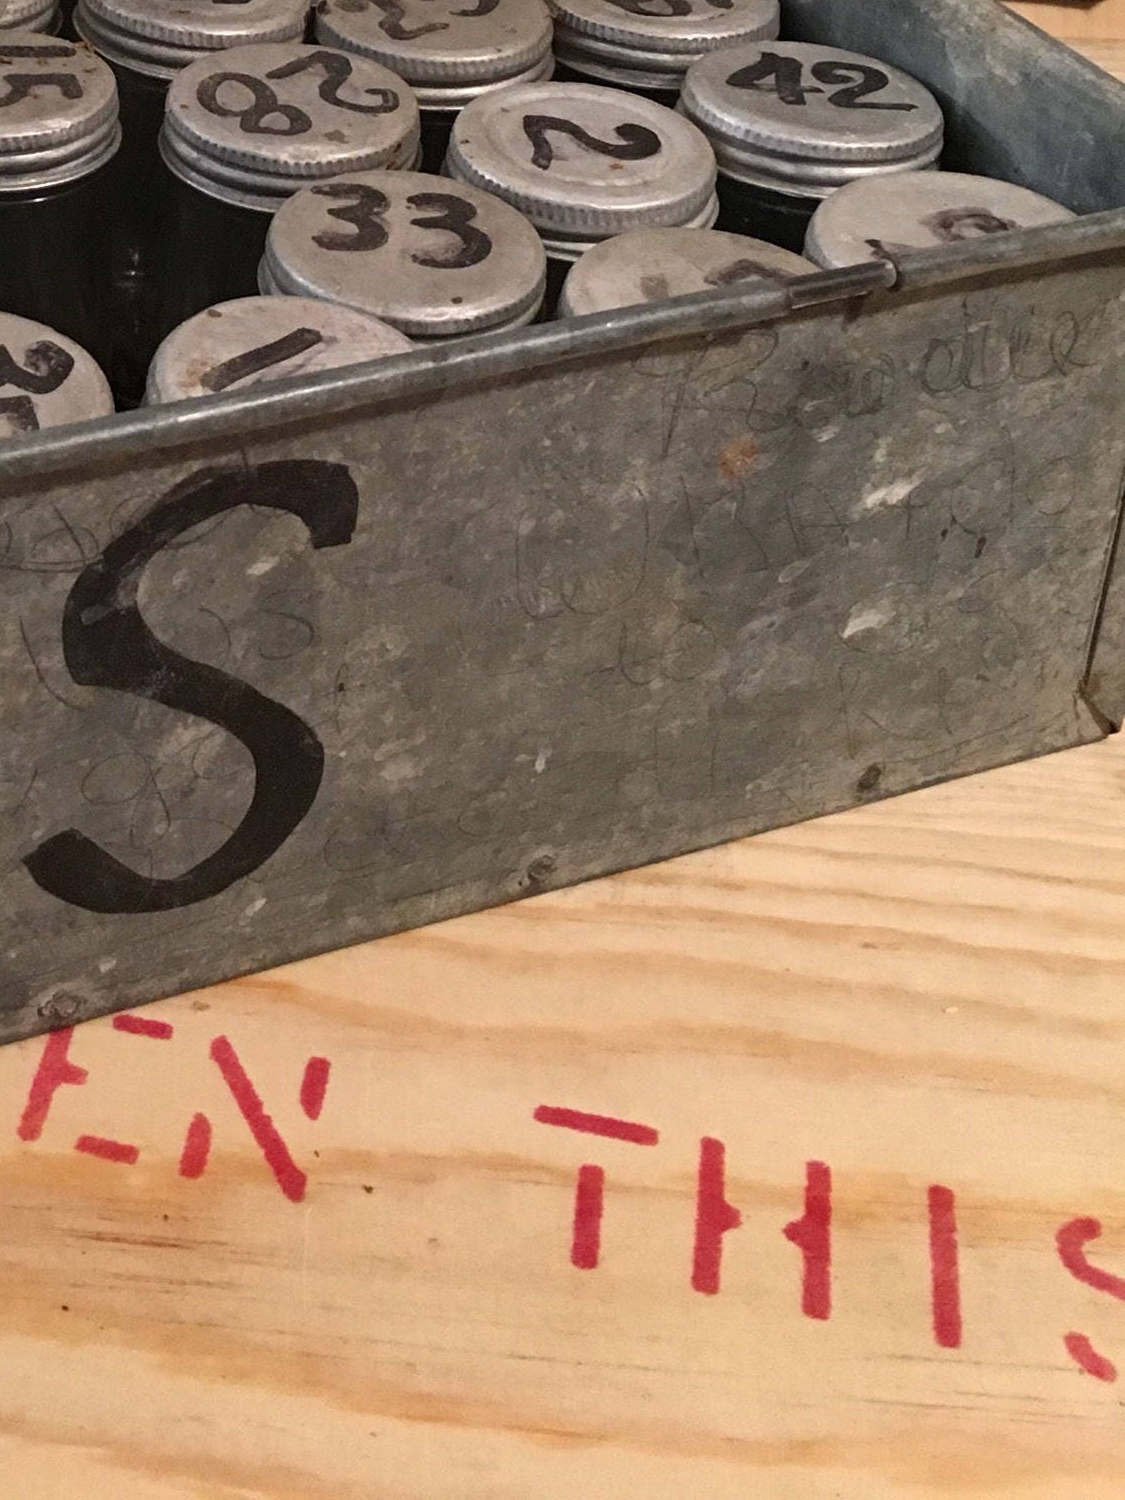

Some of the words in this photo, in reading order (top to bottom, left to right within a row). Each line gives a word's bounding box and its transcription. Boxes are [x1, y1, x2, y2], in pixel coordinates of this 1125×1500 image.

[196, 50, 401, 136] 28
[726, 52, 917, 112] 42
[523, 113, 662, 170] 2
[310, 183, 492, 269] 33
[21, 458, 359, 915] S
